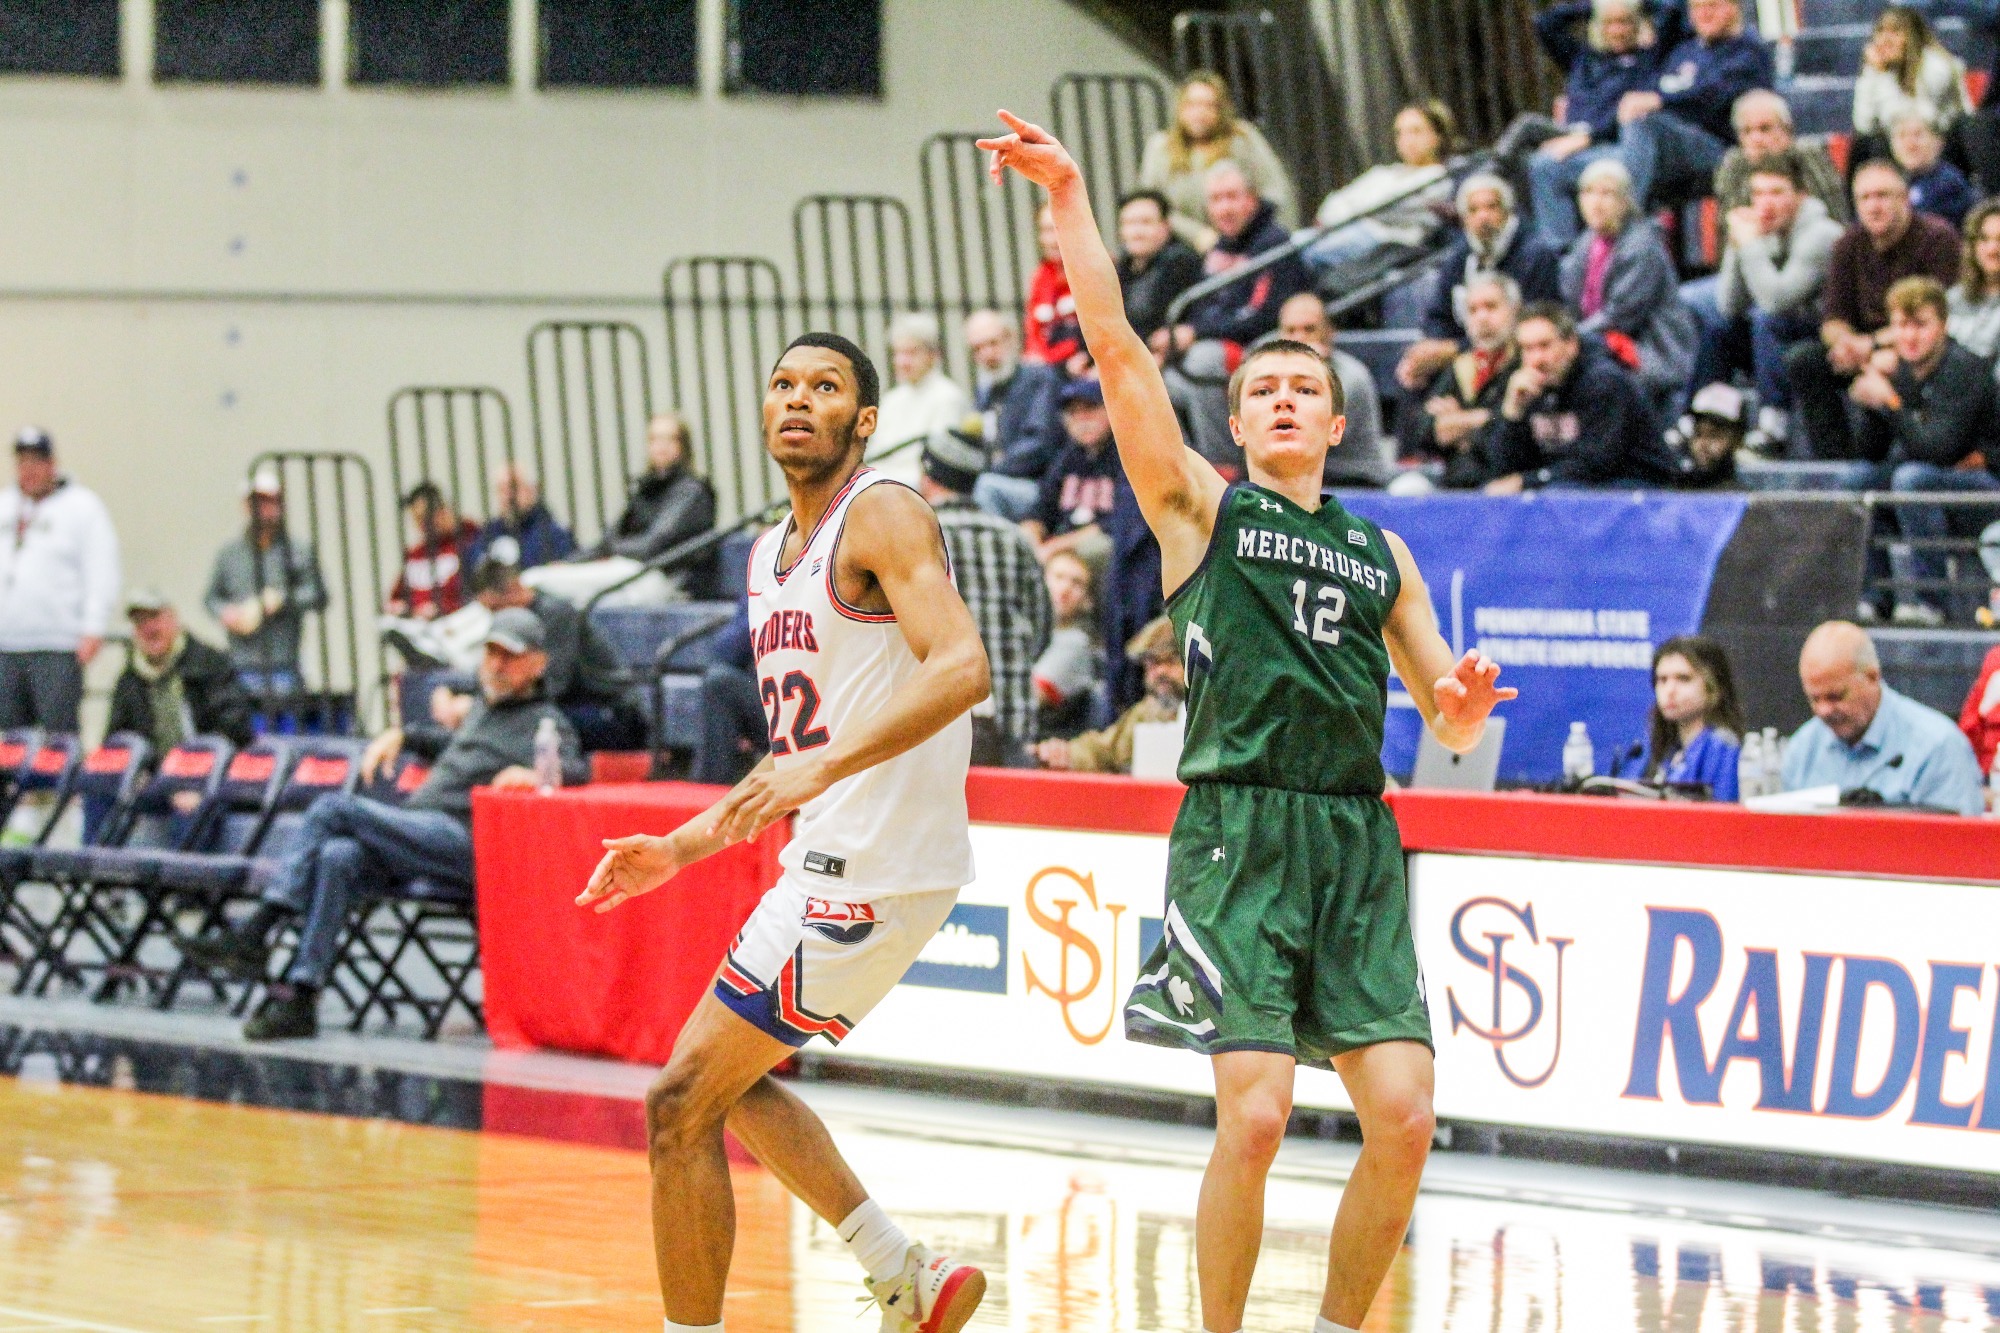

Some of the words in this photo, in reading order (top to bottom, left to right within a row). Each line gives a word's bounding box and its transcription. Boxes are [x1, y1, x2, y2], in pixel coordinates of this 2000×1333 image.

[1236, 528, 1388, 597] MERCYHURST
[1292, 579, 1346, 646] 12
[761, 669, 831, 757] 22
[1620, 905, 2000, 1134] RAIDE
